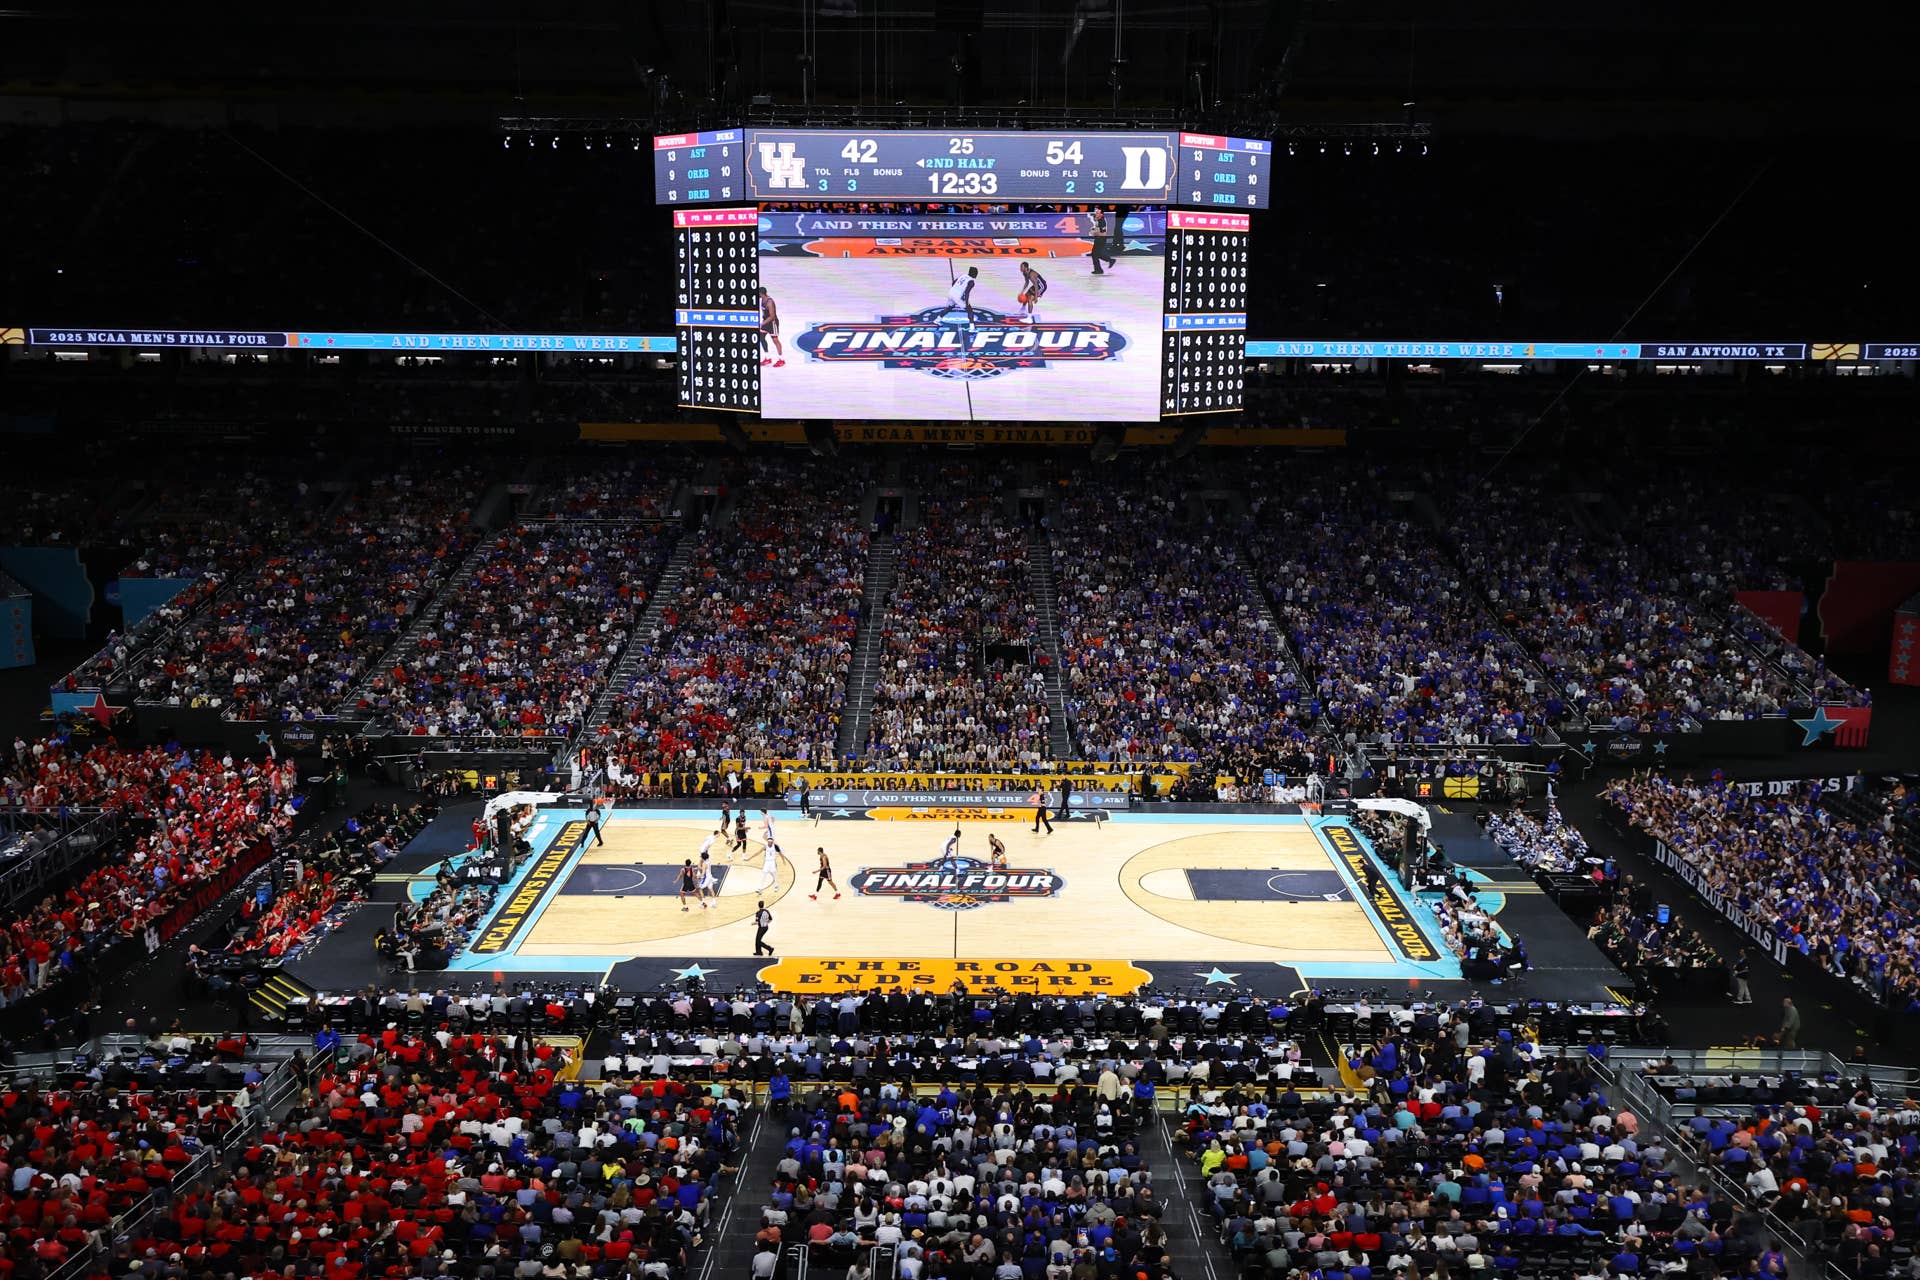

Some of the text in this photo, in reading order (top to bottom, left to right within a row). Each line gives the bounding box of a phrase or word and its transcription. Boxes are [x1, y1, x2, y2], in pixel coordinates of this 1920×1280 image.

[716, 131, 735, 141] DUKE
[841, 139, 878, 163] 42
[949, 138, 974, 155] 25
[1045, 141, 1084, 165] 54
[667, 146, 728, 162] 13 AST 6
[1193, 150, 1257, 167] 13 AST 6
[926, 158, 995, 169] 2ND HALF
[1120, 147, 1167, 189] D
[669, 165, 731, 181] 9 OREB 10
[815, 168, 903, 177] TOL FLS BONUS
[1020, 169, 1108, 178] BONUS FLS TOL
[1194, 170, 1257, 186] 9 OREB 10
[818, 179, 857, 192] 3 3
[928, 172, 998, 194] 12:33
[1065, 181, 1105, 193] 2 3
[668, 187, 731, 201] 13 DREB 15
[1192, 191, 1256, 206] 13 DREB 15
[811, 217, 1080, 234] AND THEN THERE WERE 4
[678, 231, 755, 243] 4 18 3 1 0 0 1
[912, 238, 988, 247] SAN
[865, 247, 1038, 255] ANTONIO
[679, 263, 757, 274] 7 7 3 1 0 0 3
[49, 332, 268, 345] 2025 NCAA MEN'S FINAL FOUR
[391, 337, 652, 351] AND THEN THERE WERE 4
[681, 330, 758, 344] 2 18 4 4 2 2 0
[817, 331, 1110, 349] FINAL FOUR
[1277, 343, 1535, 357] AND THEN THERE WERE 4
[1657, 347, 1785, 358] SAN ANTONIO, TX
[1884, 347, 1917, 357] 2025
[1167, 379, 1243, 394] 7 15 5 2 0 0 0
[863, 430, 914, 441] NCAA
[923, 430, 985, 441] MEN'S
[993, 430, 1059, 441] FINAL
[823, 777, 870, 790] 2025
[989, 778, 1045, 791] FINAL
[1050, 779, 1098, 791] FUR
[940, 795, 983, 803] THERE
[477, 821, 588, 951] NCAA MEN'S FINAL FOUR
[863, 875, 1054, 888] FINAL FOUR
[1327, 827, 1359, 853] NCAA
[1390, 923, 1432, 958] FOUR
[1667, 849, 1772, 951] DUKE BLUE DEVILS
[820, 961, 1093, 972] THE ROAD
[797, 974, 1113, 986] ENDS HERE
